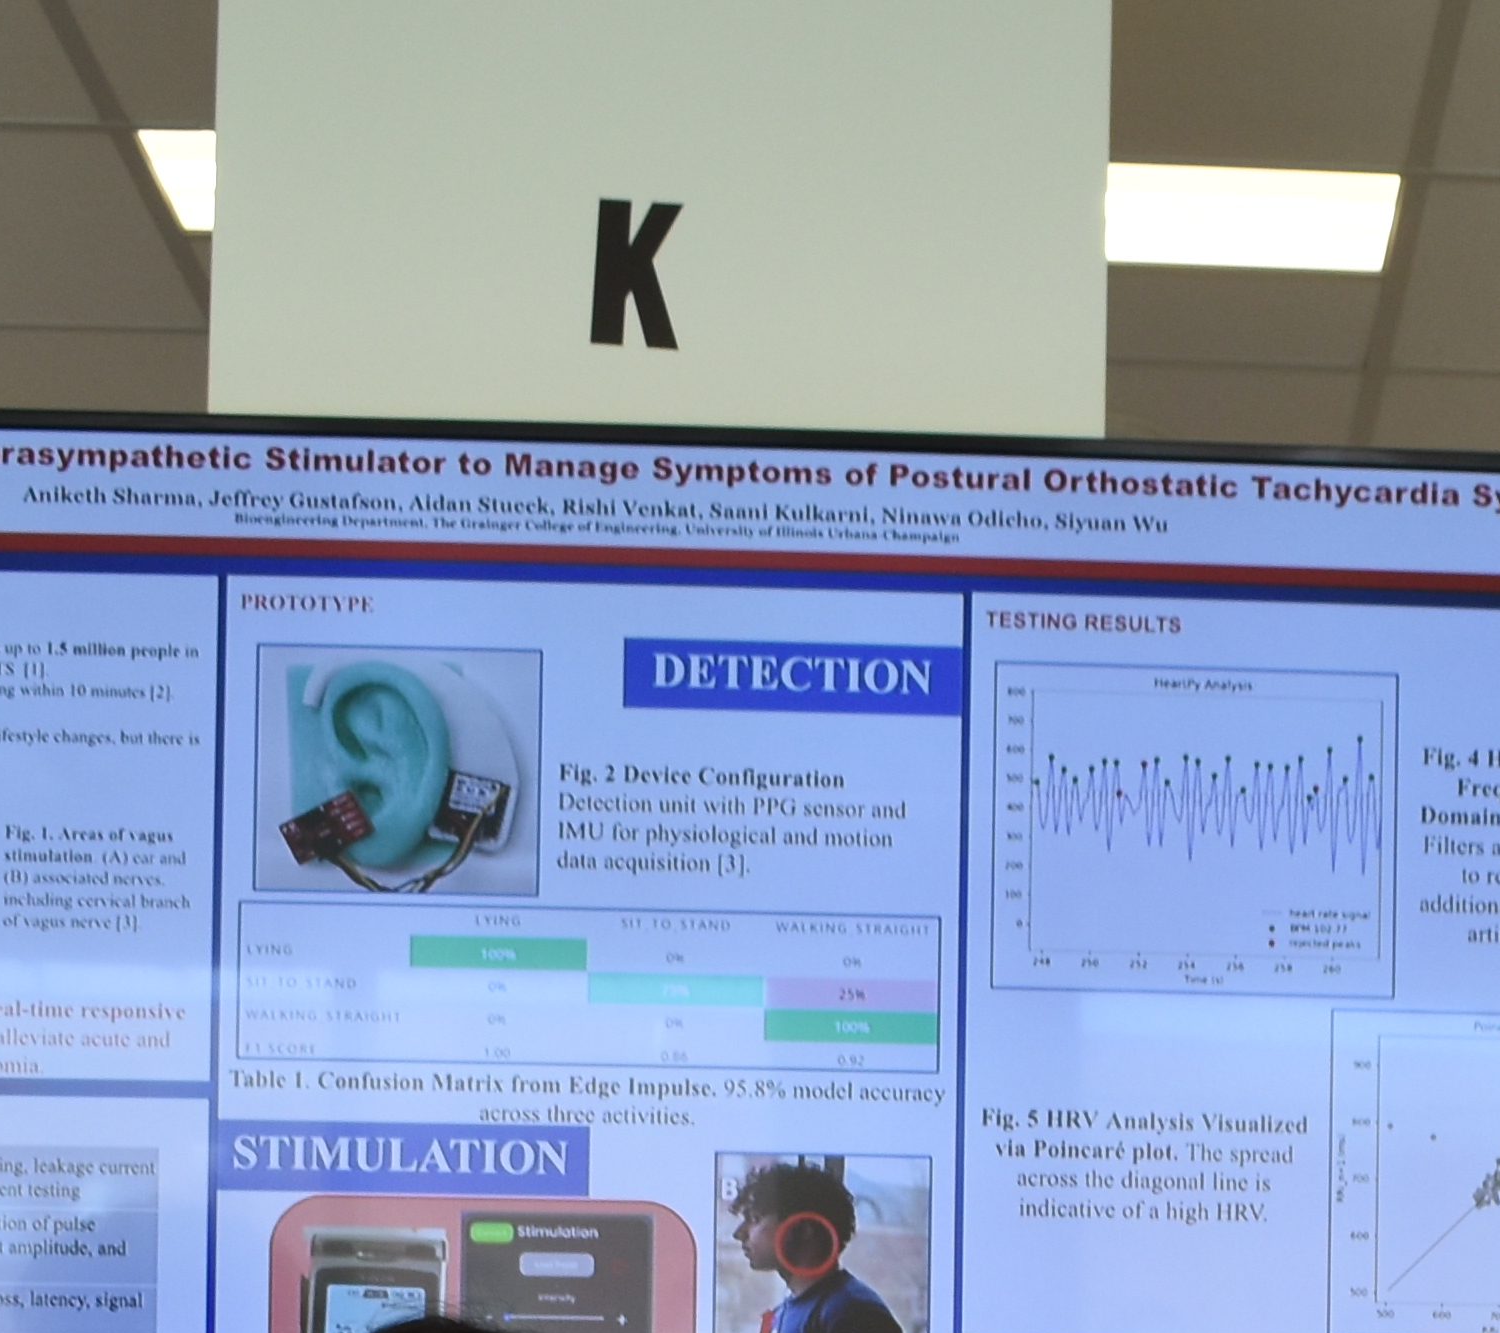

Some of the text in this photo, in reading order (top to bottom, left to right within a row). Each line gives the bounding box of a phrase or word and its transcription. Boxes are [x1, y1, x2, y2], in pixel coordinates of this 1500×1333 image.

[590, 198, 684, 350] K
[265, 446, 446, 474] Stimulator
[458, 452, 491, 476] to
[505, 452, 639, 485] Manage
[652, 456, 831, 488] Symptoms
[845, 462, 877, 486] of
[889, 463, 1030, 491] Postural
[1043, 468, 1237, 498] Orthostatic
[1251, 475, 1459, 508] Tachycardia
[23, 485, 106, 504] Aniketh
[208, 489, 283, 512] Jeffrey
[409, 493, 471, 513] Aidan
[563, 497, 615, 516] Rishi
[709, 502, 767, 521] Saani
[882, 506, 961, 526] Ninawa
[1055, 512, 1125, 534] Siyuan
[1132, 515, 1167, 533] Wu
[241, 593, 372, 612] PROTOTYPE
[986, 610, 1181, 634] TESTING RESULTS
[654, 652, 930, 695] DETECTION
[1423, 747, 1460, 770] Fig.
[1468, 749, 1479, 767] 4
[559, 763, 844, 791] Fig. 2 Device Configuration
[559, 791, 905, 819] Detection unit with PPG sensor and
[1421, 805, 1500, 826] Domain
[558, 820, 892, 849] IMU for physiological and motion
[1424, 835, 1484, 856] Filters
[556, 849, 596, 869] data
[604, 851, 710, 876] acquisition
[1461, 868, 1480, 884] to
[229, 1069, 286, 1088] Table
[317, 1071, 423, 1091] Confusion
[432, 1073, 502, 1093] Matrix
[511, 1074, 560, 1094] from
[569, 1075, 620, 1099] Edge
[724, 1079, 786, 1099] 95.8%
[793, 1080, 852, 1100] model
[859, 1087, 945, 1107] accuracy
[479, 1108, 540, 1125] across
[547, 1105, 595, 1126] three
[982, 1107, 1307, 1135] Fig. 5 HRV Analysis Visualized
[233, 1134, 567, 1175] STIMULATION
[995, 1138, 1025, 1157] via
[1034, 1138, 1125, 1160] Poincaré
[1186, 1142, 1222, 1162] The
[1230, 1144, 1292, 1168] spread
[33, 1157, 94, 1178] leakage
[98, 1160, 155, 1176] current
[1017, 1168, 1270, 1194] across the diagonal line is
[1019, 1197, 1115, 1219] indicative
[1122, 1199, 1145, 1219] of
[1149, 1206, 1159, 1219] a
[1166, 1200, 1208, 1226] high
